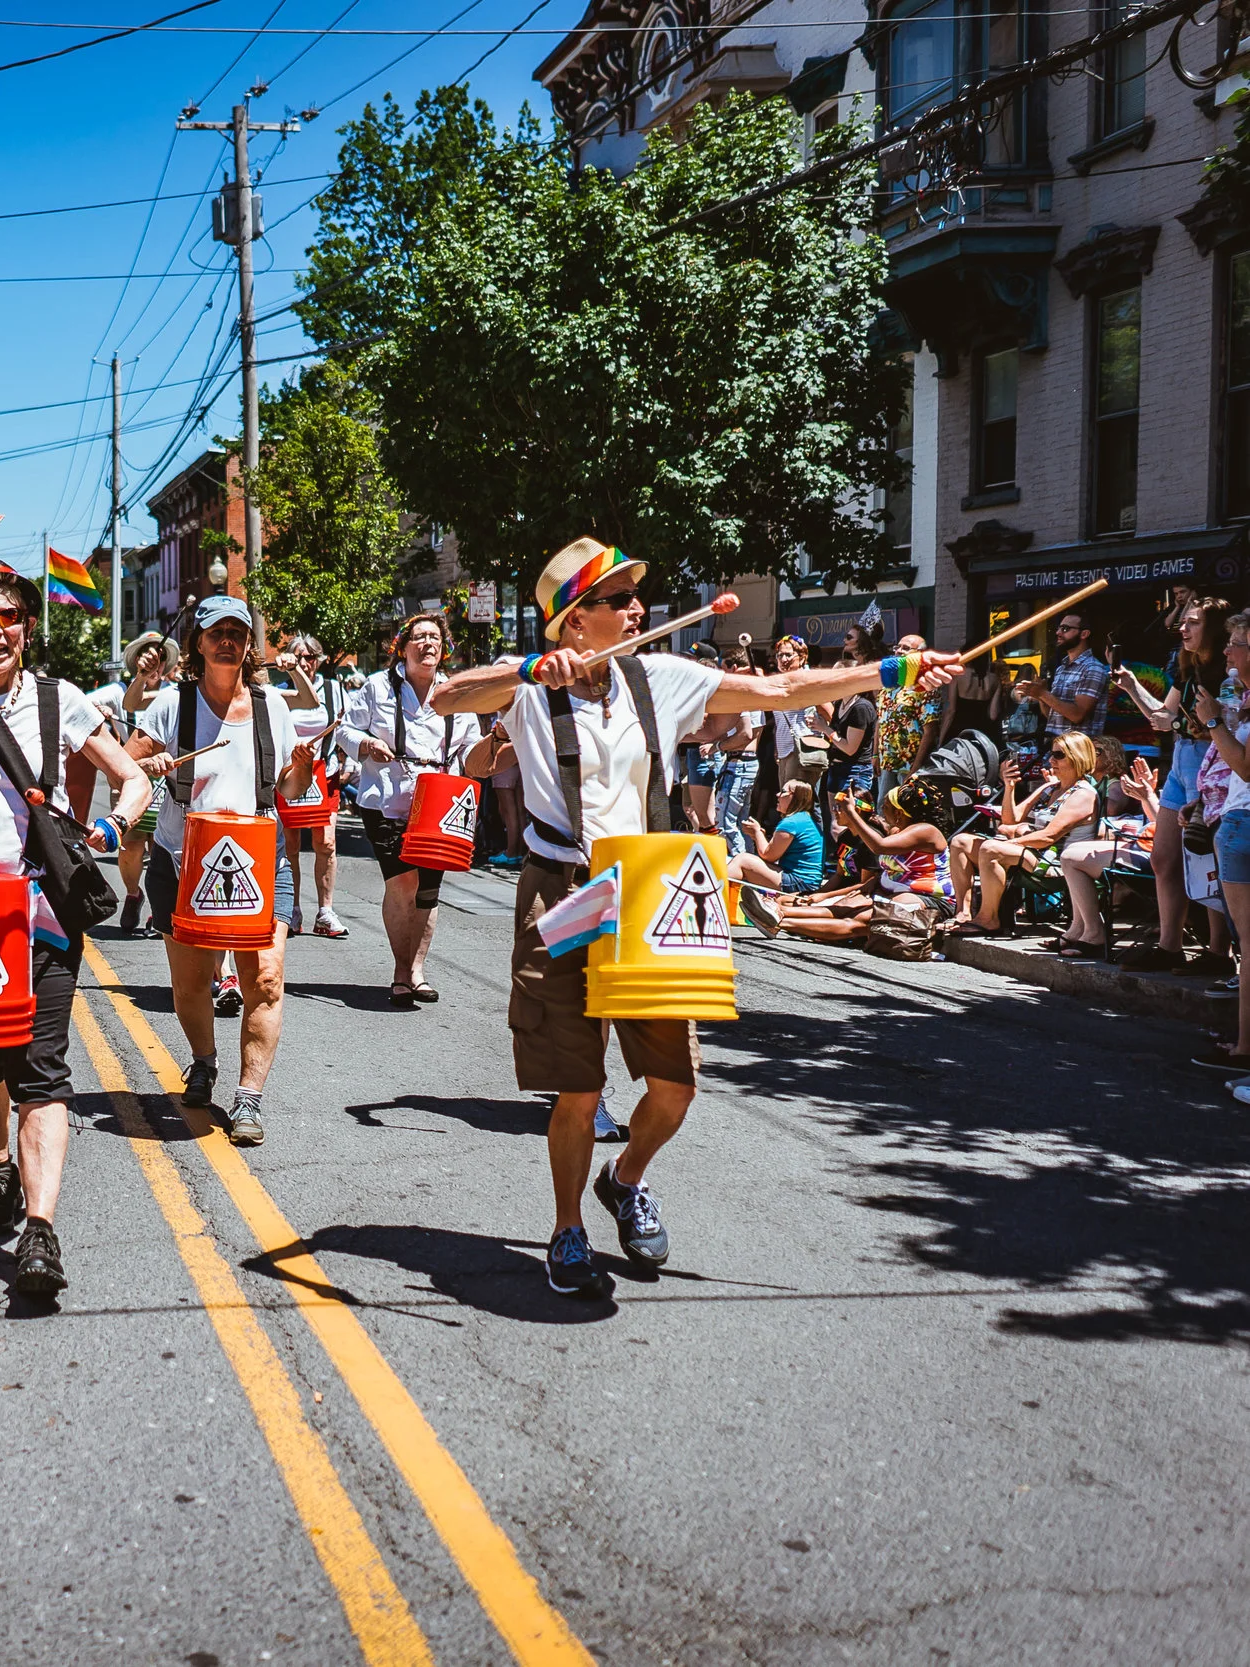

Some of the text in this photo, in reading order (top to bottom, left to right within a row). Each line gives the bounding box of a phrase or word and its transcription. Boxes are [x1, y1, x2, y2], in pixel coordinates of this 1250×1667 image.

[1015, 557, 1194, 587] PASTIME LEGENDS VIDEO GAMES
[662, 896, 684, 926] RHYTHM
